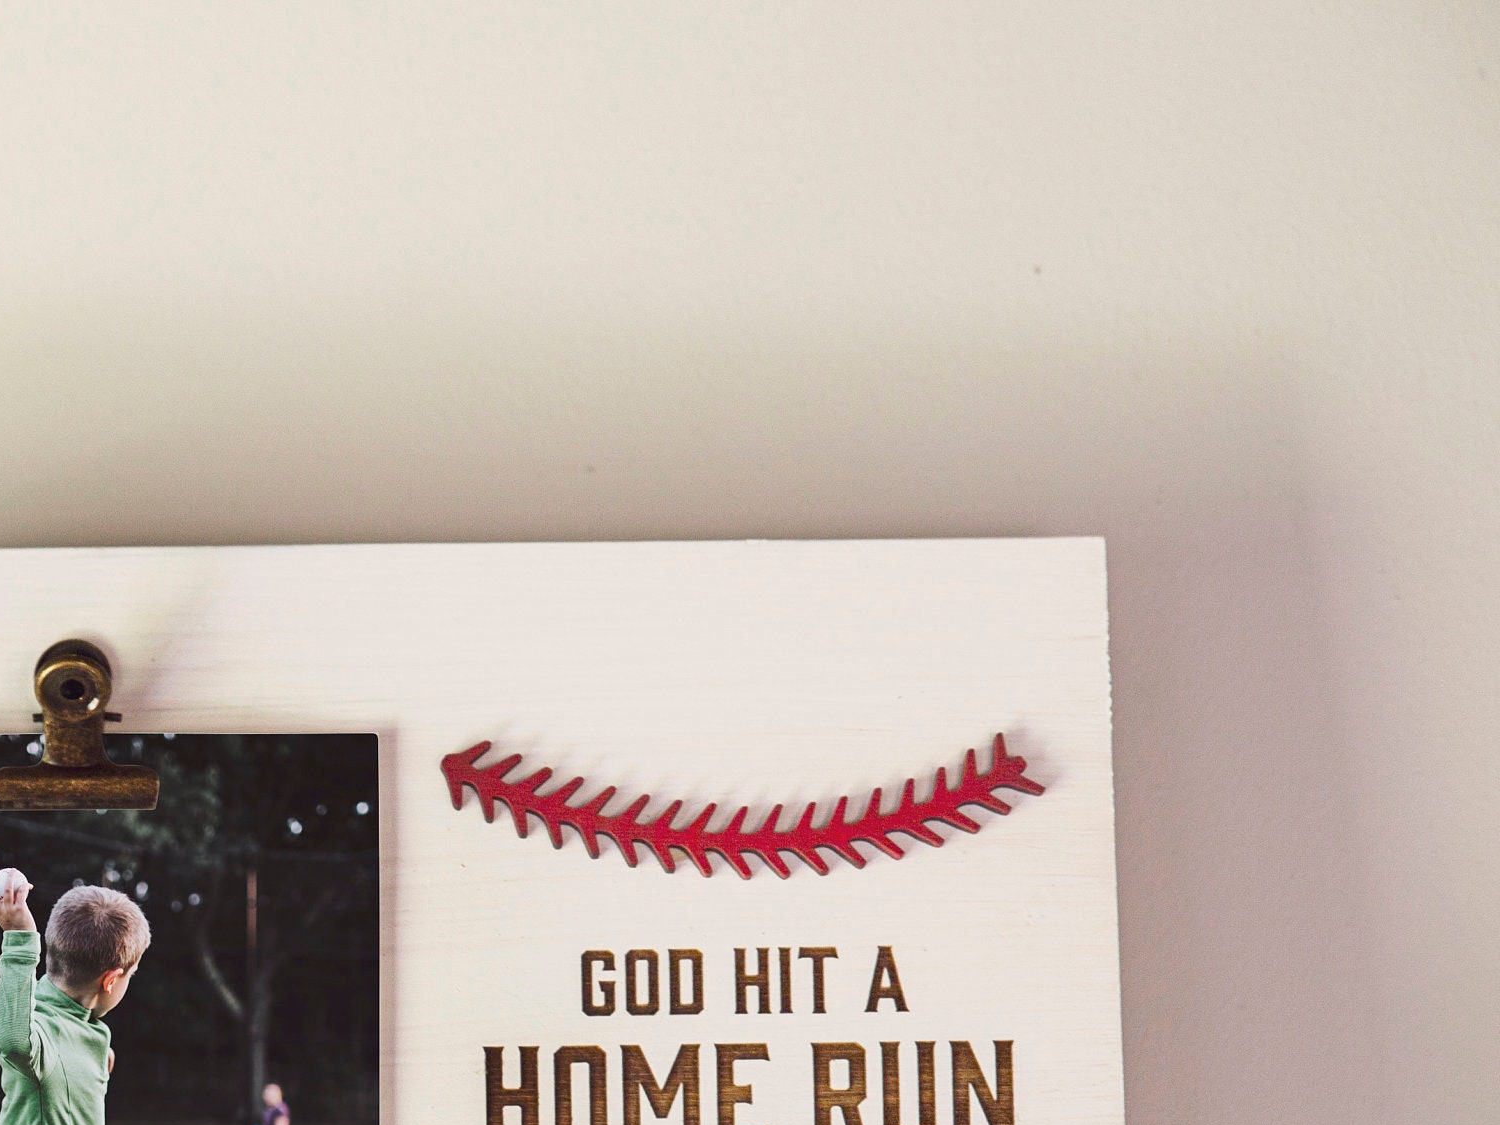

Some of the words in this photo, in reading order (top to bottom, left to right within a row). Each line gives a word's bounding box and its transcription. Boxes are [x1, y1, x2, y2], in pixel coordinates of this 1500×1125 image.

[580, 948, 704, 1017] GOD
[733, 946, 839, 1015] HIT
[864, 945, 910, 1013] A
